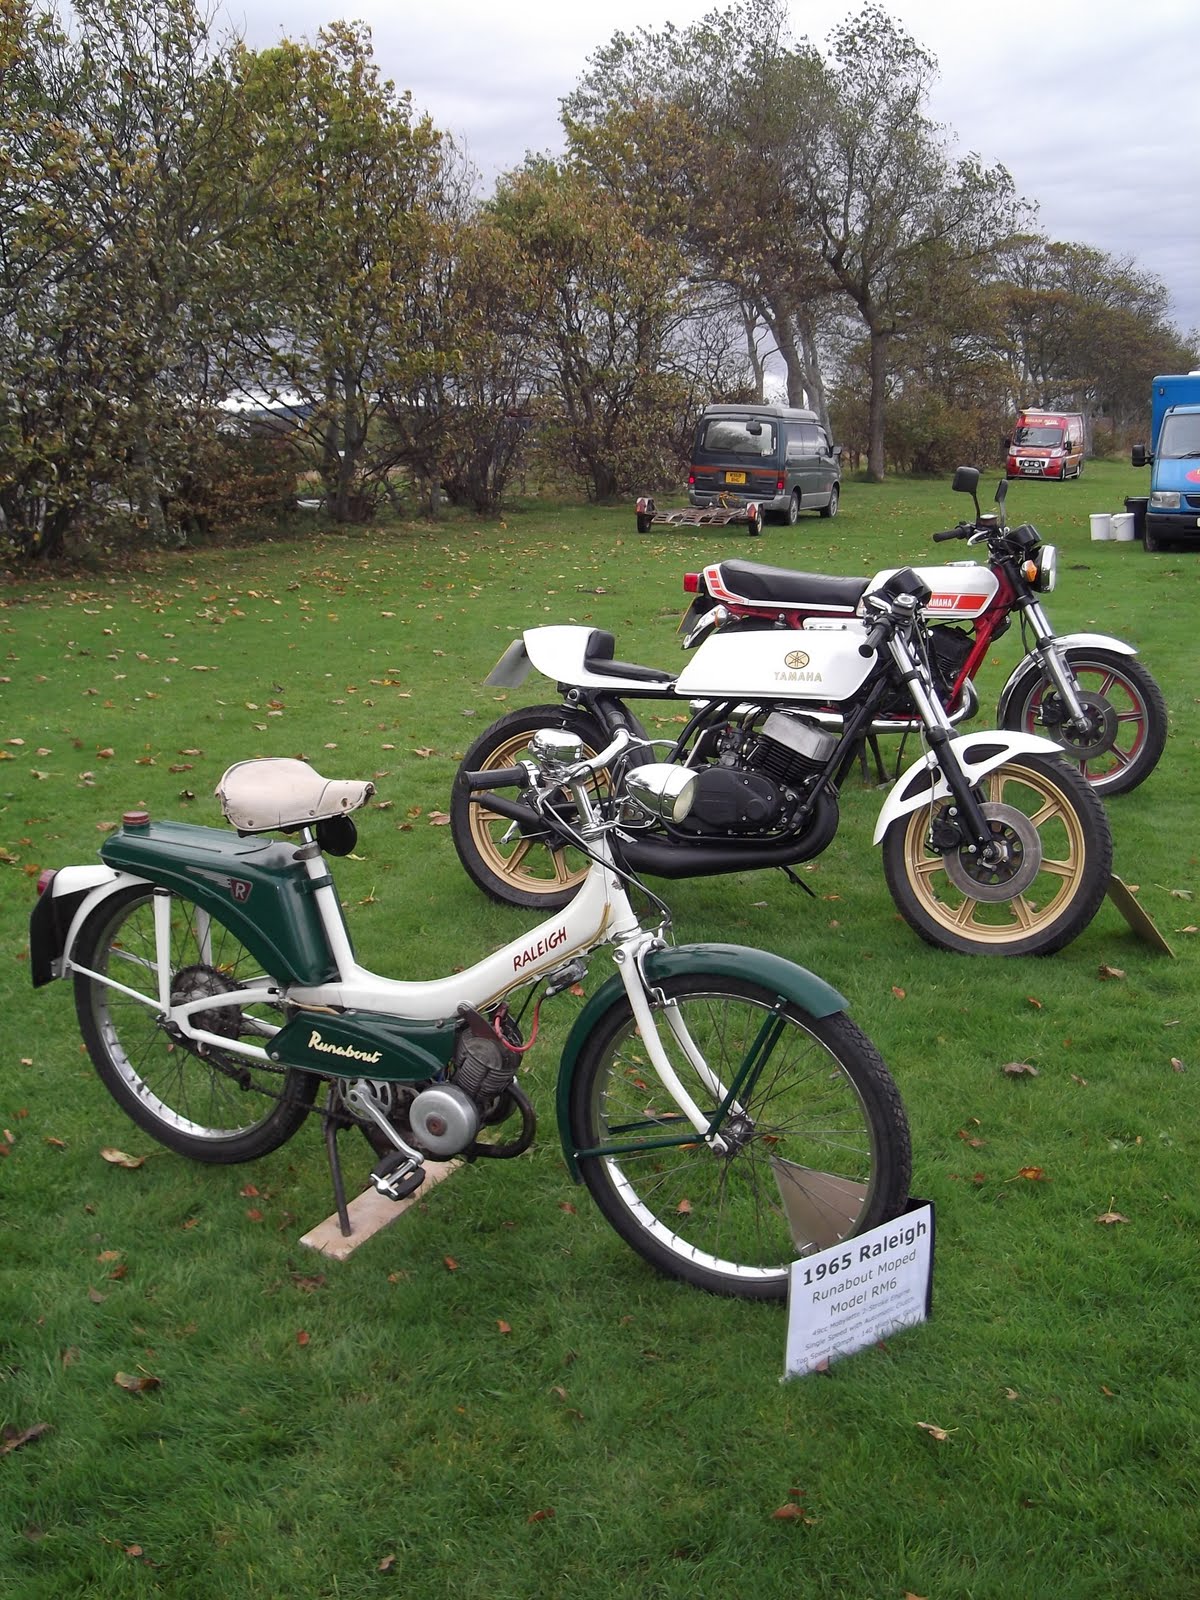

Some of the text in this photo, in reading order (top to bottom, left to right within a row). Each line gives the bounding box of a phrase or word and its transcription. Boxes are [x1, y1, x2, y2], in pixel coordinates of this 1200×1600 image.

[928, 598, 952, 608] AMAHA
[774, 671, 822, 682] YAMAHA
[235, 882, 246, 899] R
[513, 926, 567, 972] RALEIGH
[308, 1030, 383, 1064] Runabout
[803, 1221, 927, 1286] 1965 Raleigh
[812, 1249, 916, 1304] Runabout Moped
[830, 1277, 897, 1316] Model RM6
[796, 1357, 809, 1366] Top
